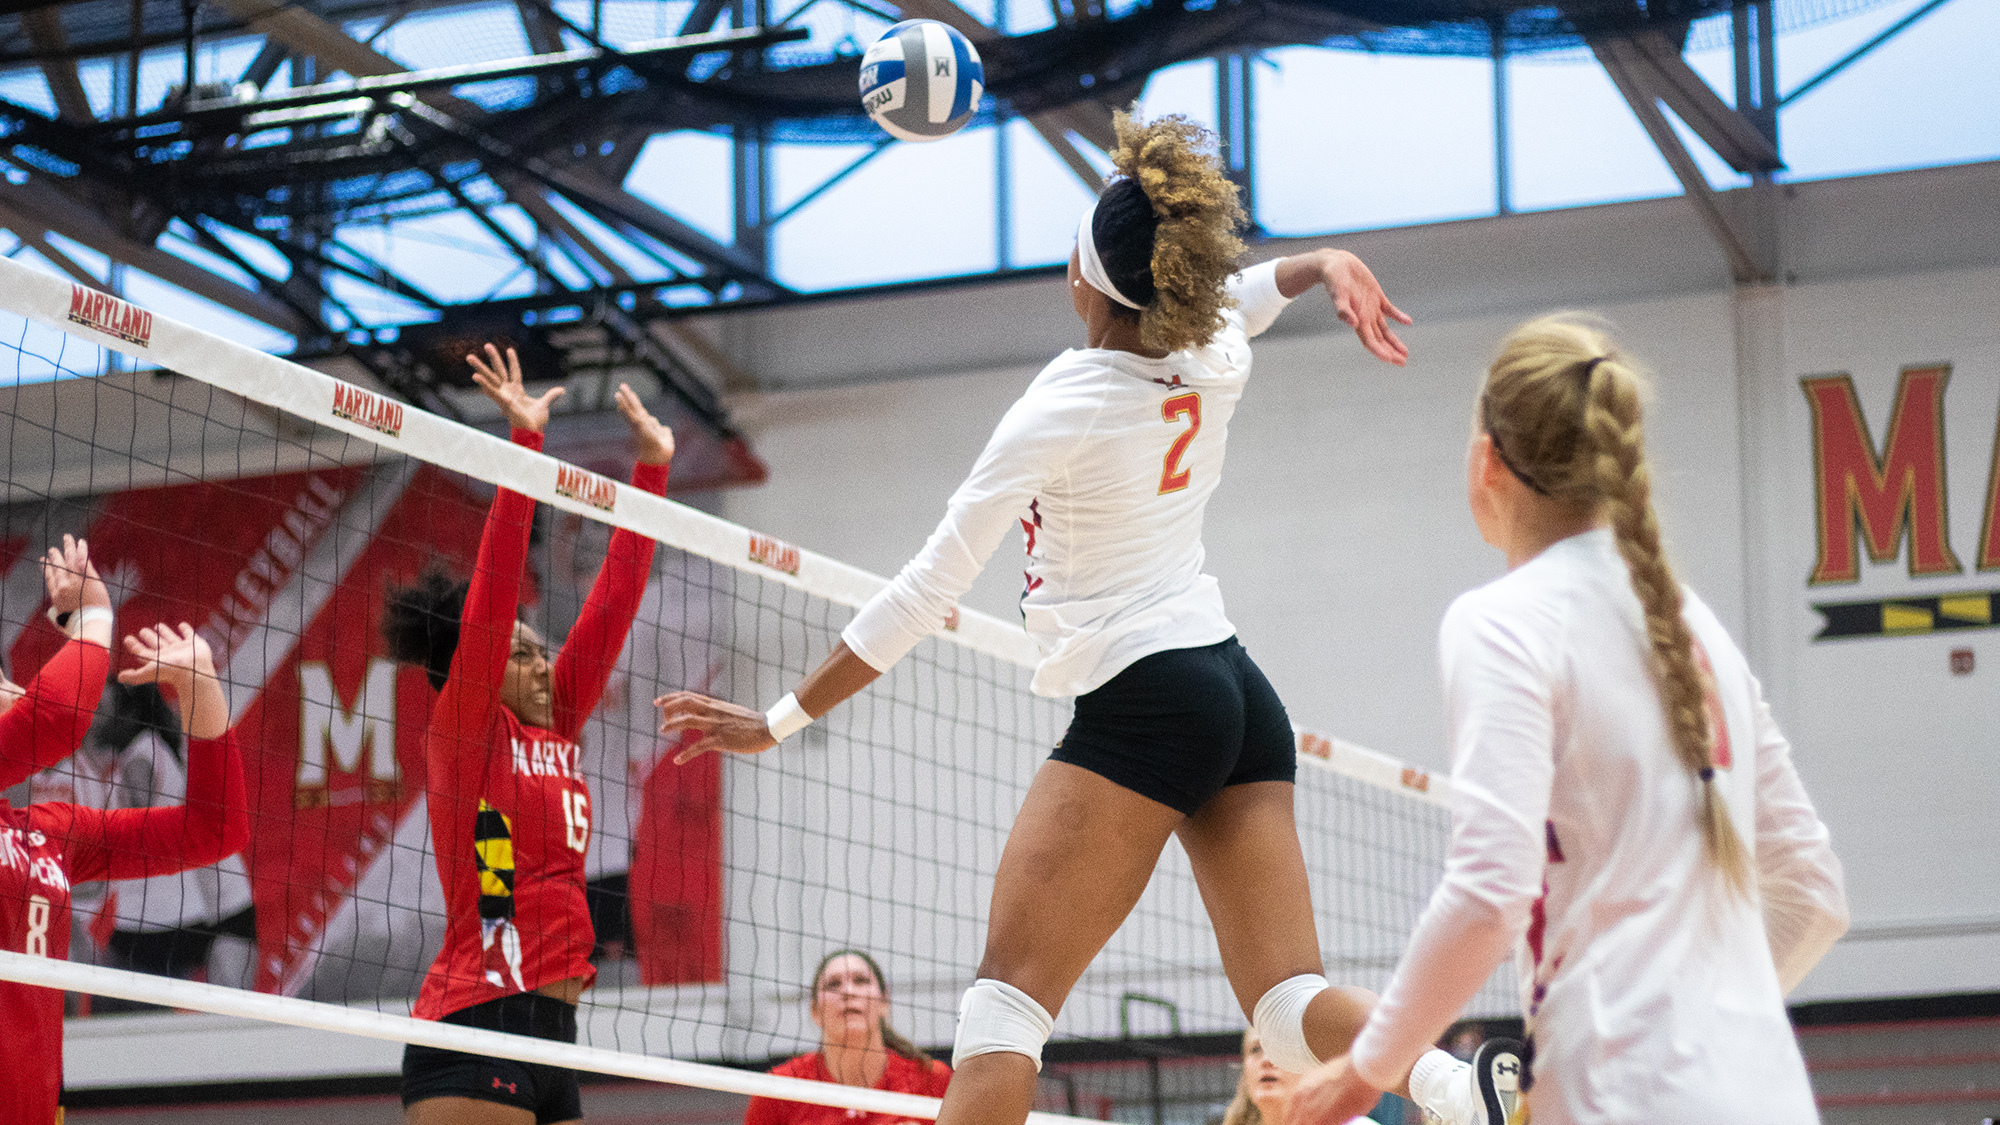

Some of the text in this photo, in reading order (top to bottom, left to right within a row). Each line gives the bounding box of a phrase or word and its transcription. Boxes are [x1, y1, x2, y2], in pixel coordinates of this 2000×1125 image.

[69, 284, 152, 341] MARYLAND
[333, 381, 403, 431] MARYLAND
[1157, 391, 1201, 496] 2
[1798, 363, 2000, 588] M
[556, 463, 616, 508] MARYLAND
[198, 473, 347, 672] OLLEYBALL
[296, 655, 403, 788] M
[562, 788, 589, 854] 15
[26, 894, 50, 958] 8
